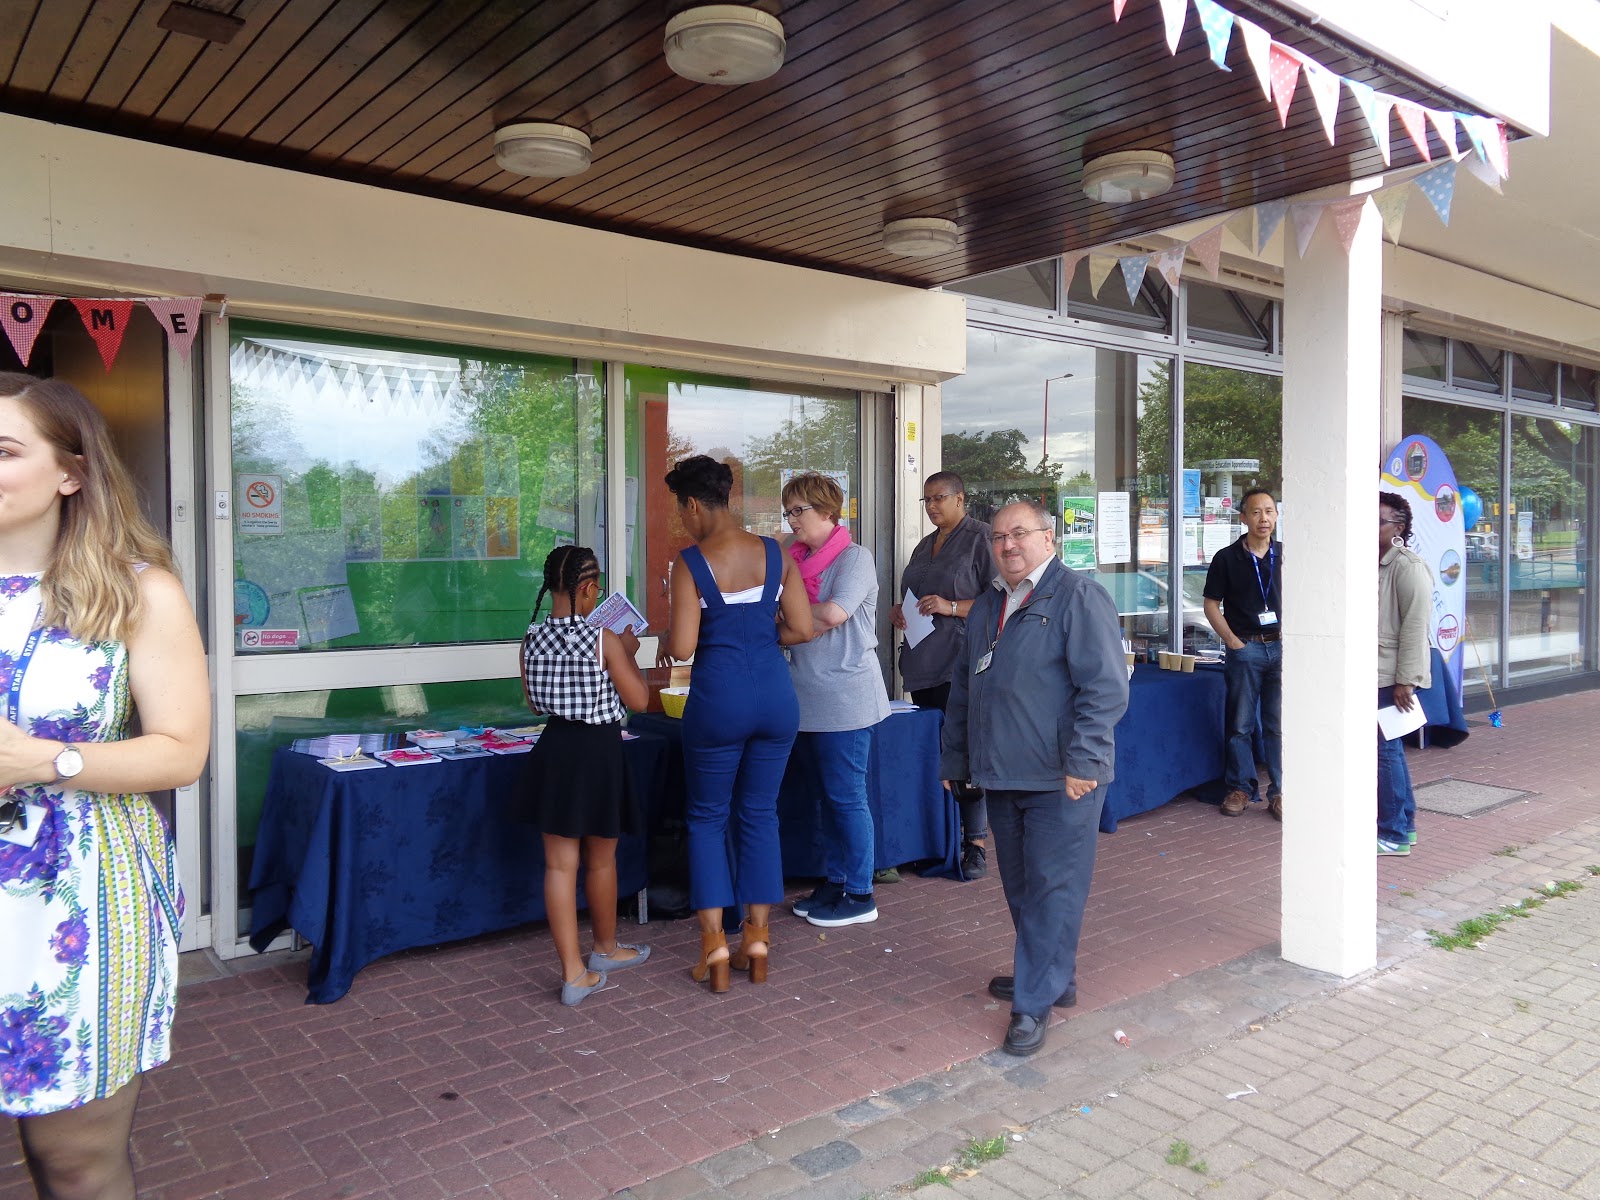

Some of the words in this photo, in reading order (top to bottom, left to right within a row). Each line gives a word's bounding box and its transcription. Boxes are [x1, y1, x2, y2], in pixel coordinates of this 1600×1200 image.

[600, 596, 619, 612] ADVICE
[23, 635, 37, 657] STAFF
[11, 668, 24, 692] STAFF
